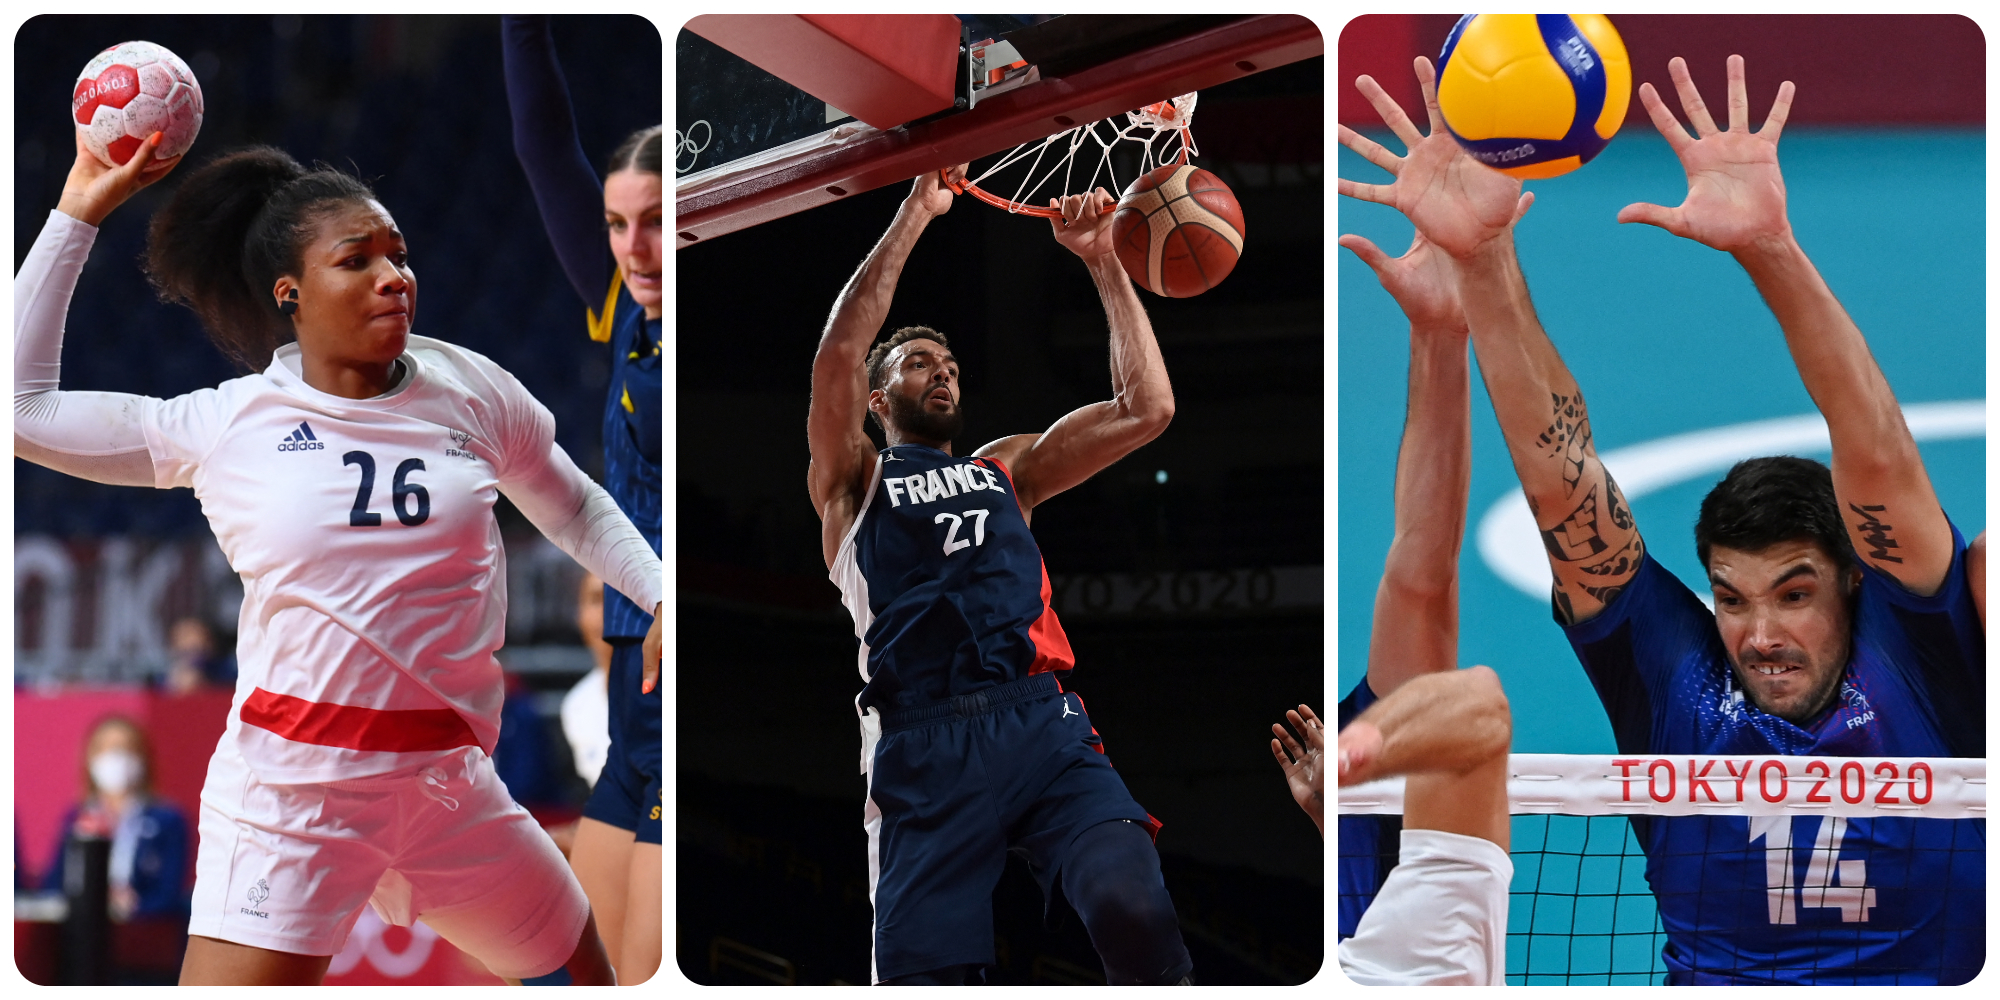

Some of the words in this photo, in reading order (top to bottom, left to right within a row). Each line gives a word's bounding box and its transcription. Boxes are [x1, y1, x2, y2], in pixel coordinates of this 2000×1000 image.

[89, 76, 129, 99] TOKYO
[277, 440, 325, 452] adidas
[445, 449, 477, 461] FRANCE
[342, 450, 431, 527] 26
[883, 463, 1007, 508] FRANCE
[934, 508, 990, 557] 27
[1130, 566, 1275, 616] 2020
[1611, 759, 1788, 803] TOKYO
[1804, 760, 1933, 805] 2020
[1747, 816, 1877, 925] 14
[240, 907, 270, 919] FRANCE
